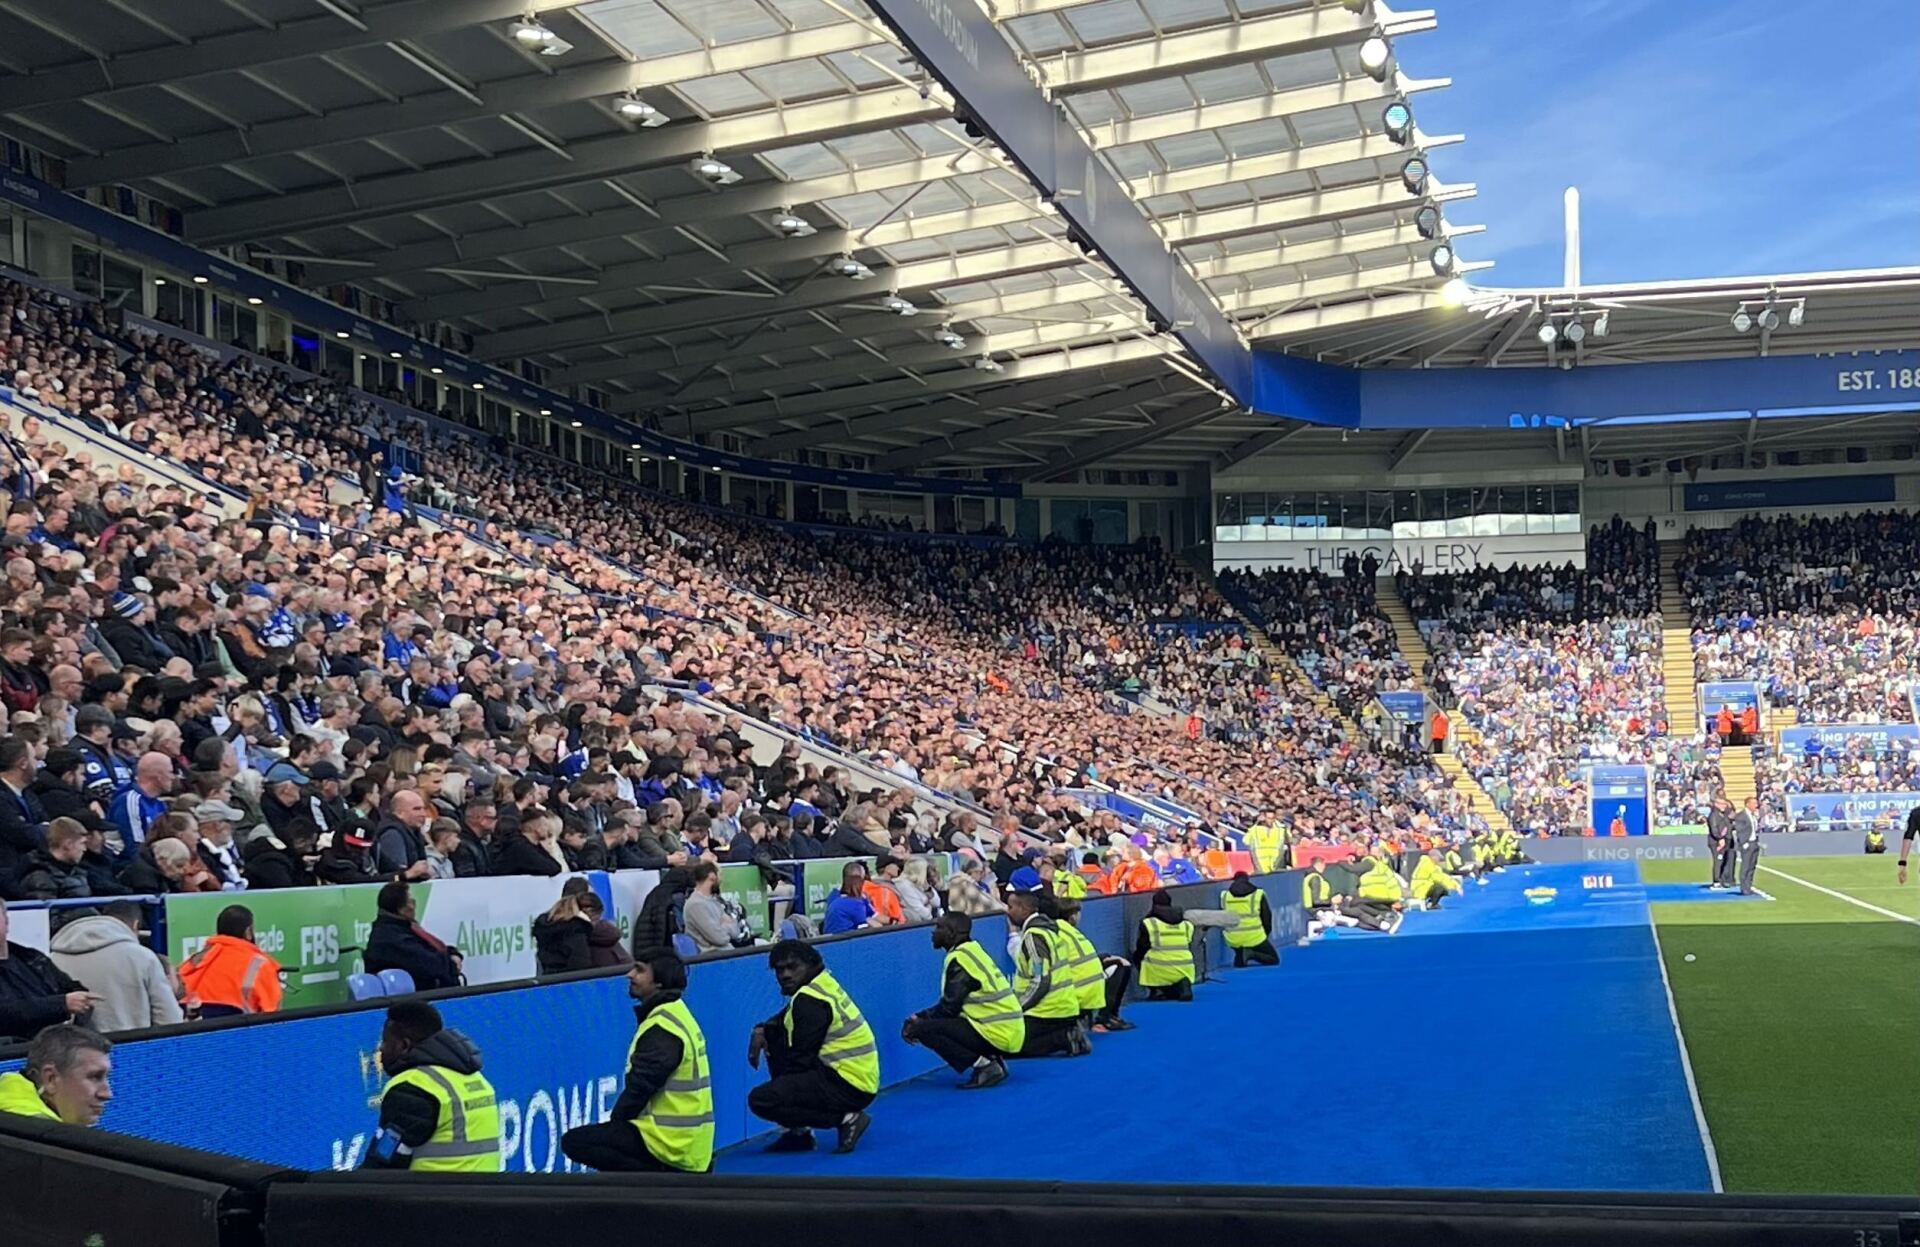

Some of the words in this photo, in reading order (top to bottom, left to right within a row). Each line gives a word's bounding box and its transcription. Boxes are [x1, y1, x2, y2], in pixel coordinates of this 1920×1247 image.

[1838, 370, 1881, 391] EST.
[1305, 547, 1349, 570] THE
[1360, 543, 1483, 571] GALLERY
[1816, 732, 1844, 742] ING
[1586, 847, 1630, 860] KING
[1635, 846, 1695, 860] POWER
[254, 924, 285, 952] rade
[300, 923, 339, 966] FBS
[354, 919, 371, 943] tra
[456, 920, 525, 963] Always
[500, 1075, 617, 1174] POWE
